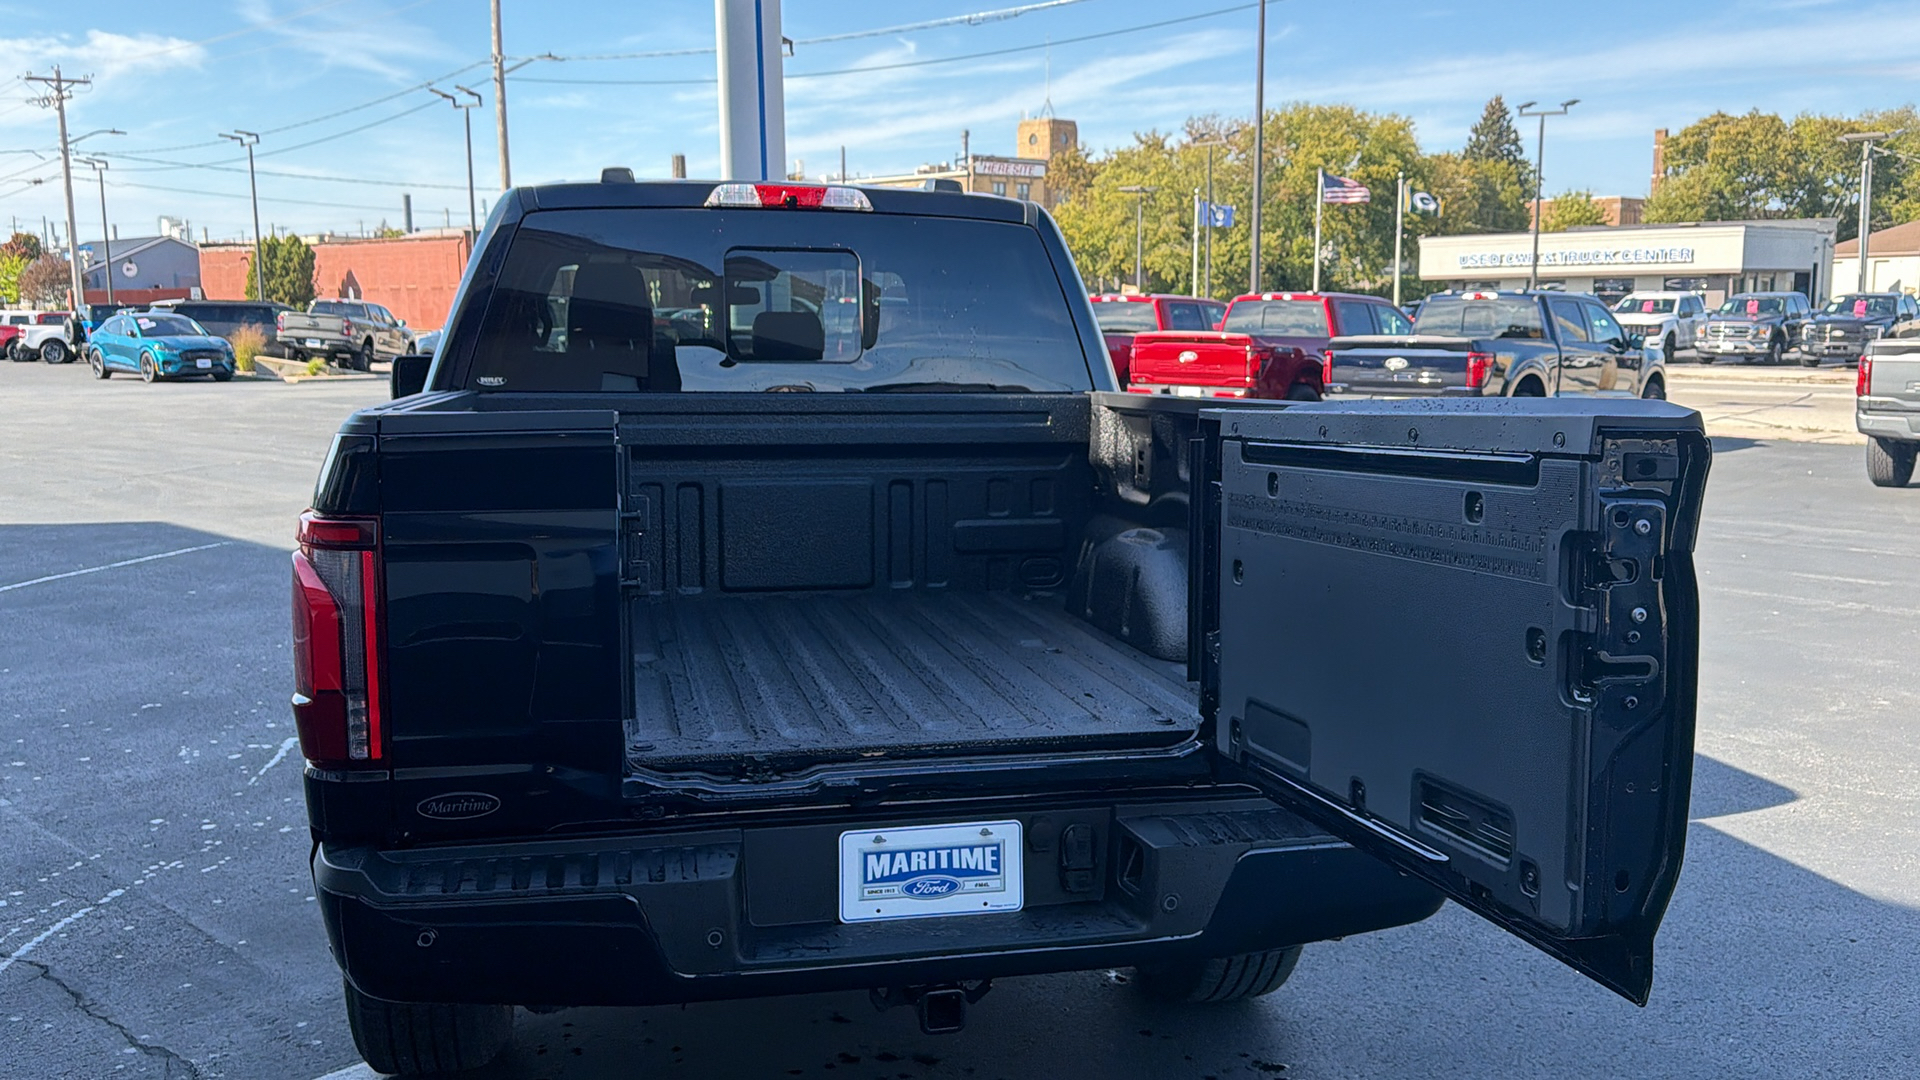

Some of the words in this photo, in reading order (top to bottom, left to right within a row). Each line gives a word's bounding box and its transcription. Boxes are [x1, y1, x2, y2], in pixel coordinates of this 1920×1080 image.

[983, 161, 1034, 175] HERESITE
[1459, 252, 1500, 266] USED
[1559, 249, 1615, 263] TRUCK
[1621, 247, 1693, 262] CENTER
[427, 798, 492, 814] Maritime
[866, 846, 998, 882] MARITIME
[912, 880, 950, 895] Ford
